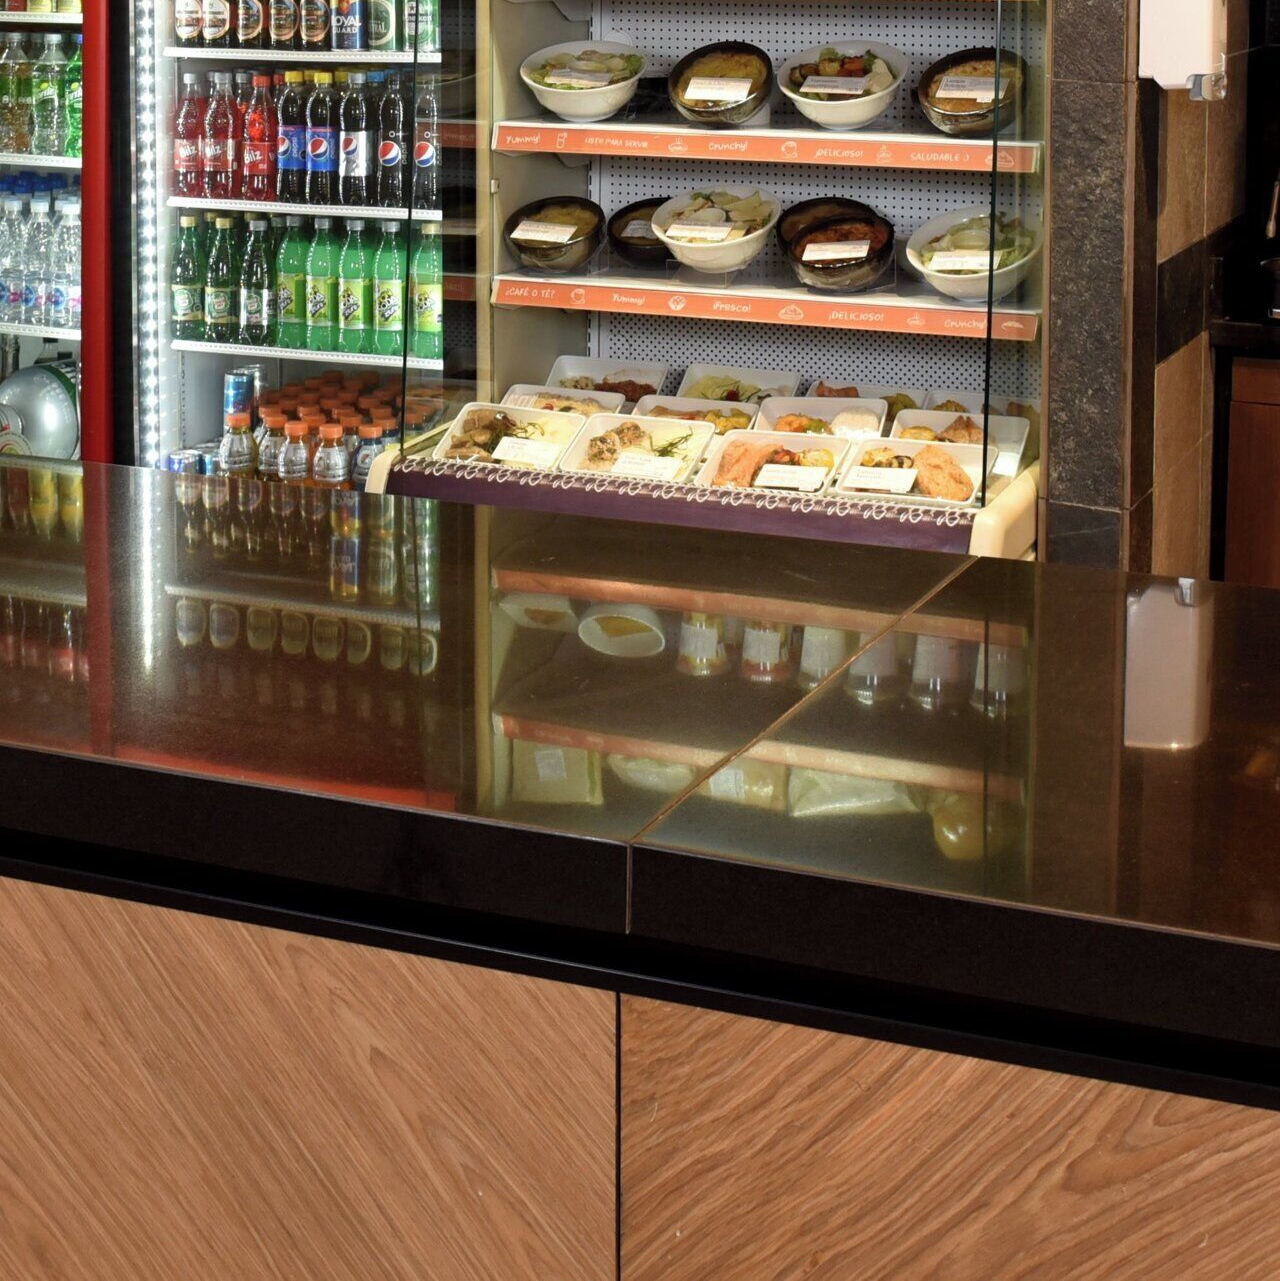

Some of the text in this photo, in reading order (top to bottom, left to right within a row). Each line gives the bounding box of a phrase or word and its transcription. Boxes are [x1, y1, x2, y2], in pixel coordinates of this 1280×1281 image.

[506, 134, 541, 146] Yummy!
[585, 136, 648, 149] LISTO PARA SERVIR
[708, 140, 749, 152] Crunchy!
[815, 149, 864, 159] ¡DELICIOSO!
[910, 152, 959, 162] SALUDABLE
[505, 285, 556, 299] ¿CAFÉ O TÉ?
[612, 294, 646, 306] Yummy!
[713, 303, 752, 314] ¡Fresco!
[828, 311, 885, 322] ¡DELICIOSO!
